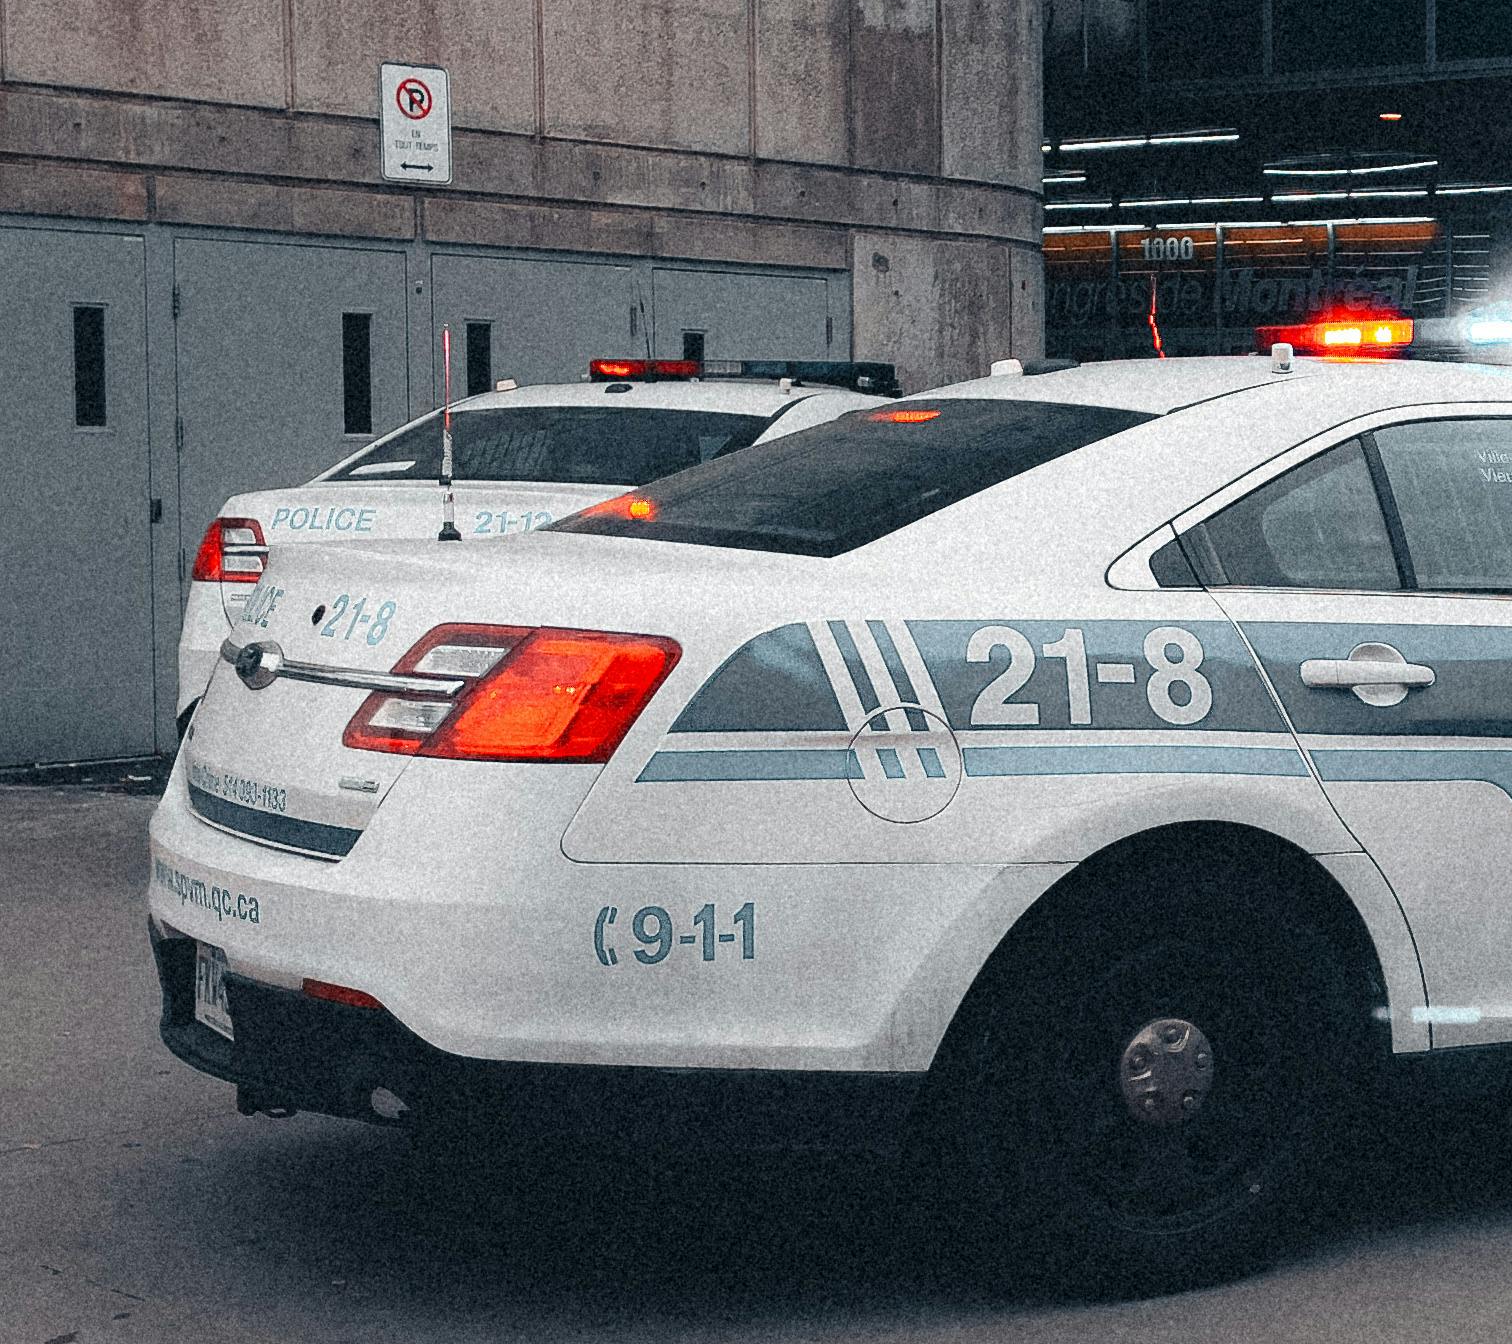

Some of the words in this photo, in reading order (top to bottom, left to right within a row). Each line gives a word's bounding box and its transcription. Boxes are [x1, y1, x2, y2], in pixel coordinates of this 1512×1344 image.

[271, 508, 376, 532] POLICE
[320, 594, 396, 646] 21-8
[965, 624, 1213, 726] 21-8
[631, 901, 757, 966] 9-1-1
